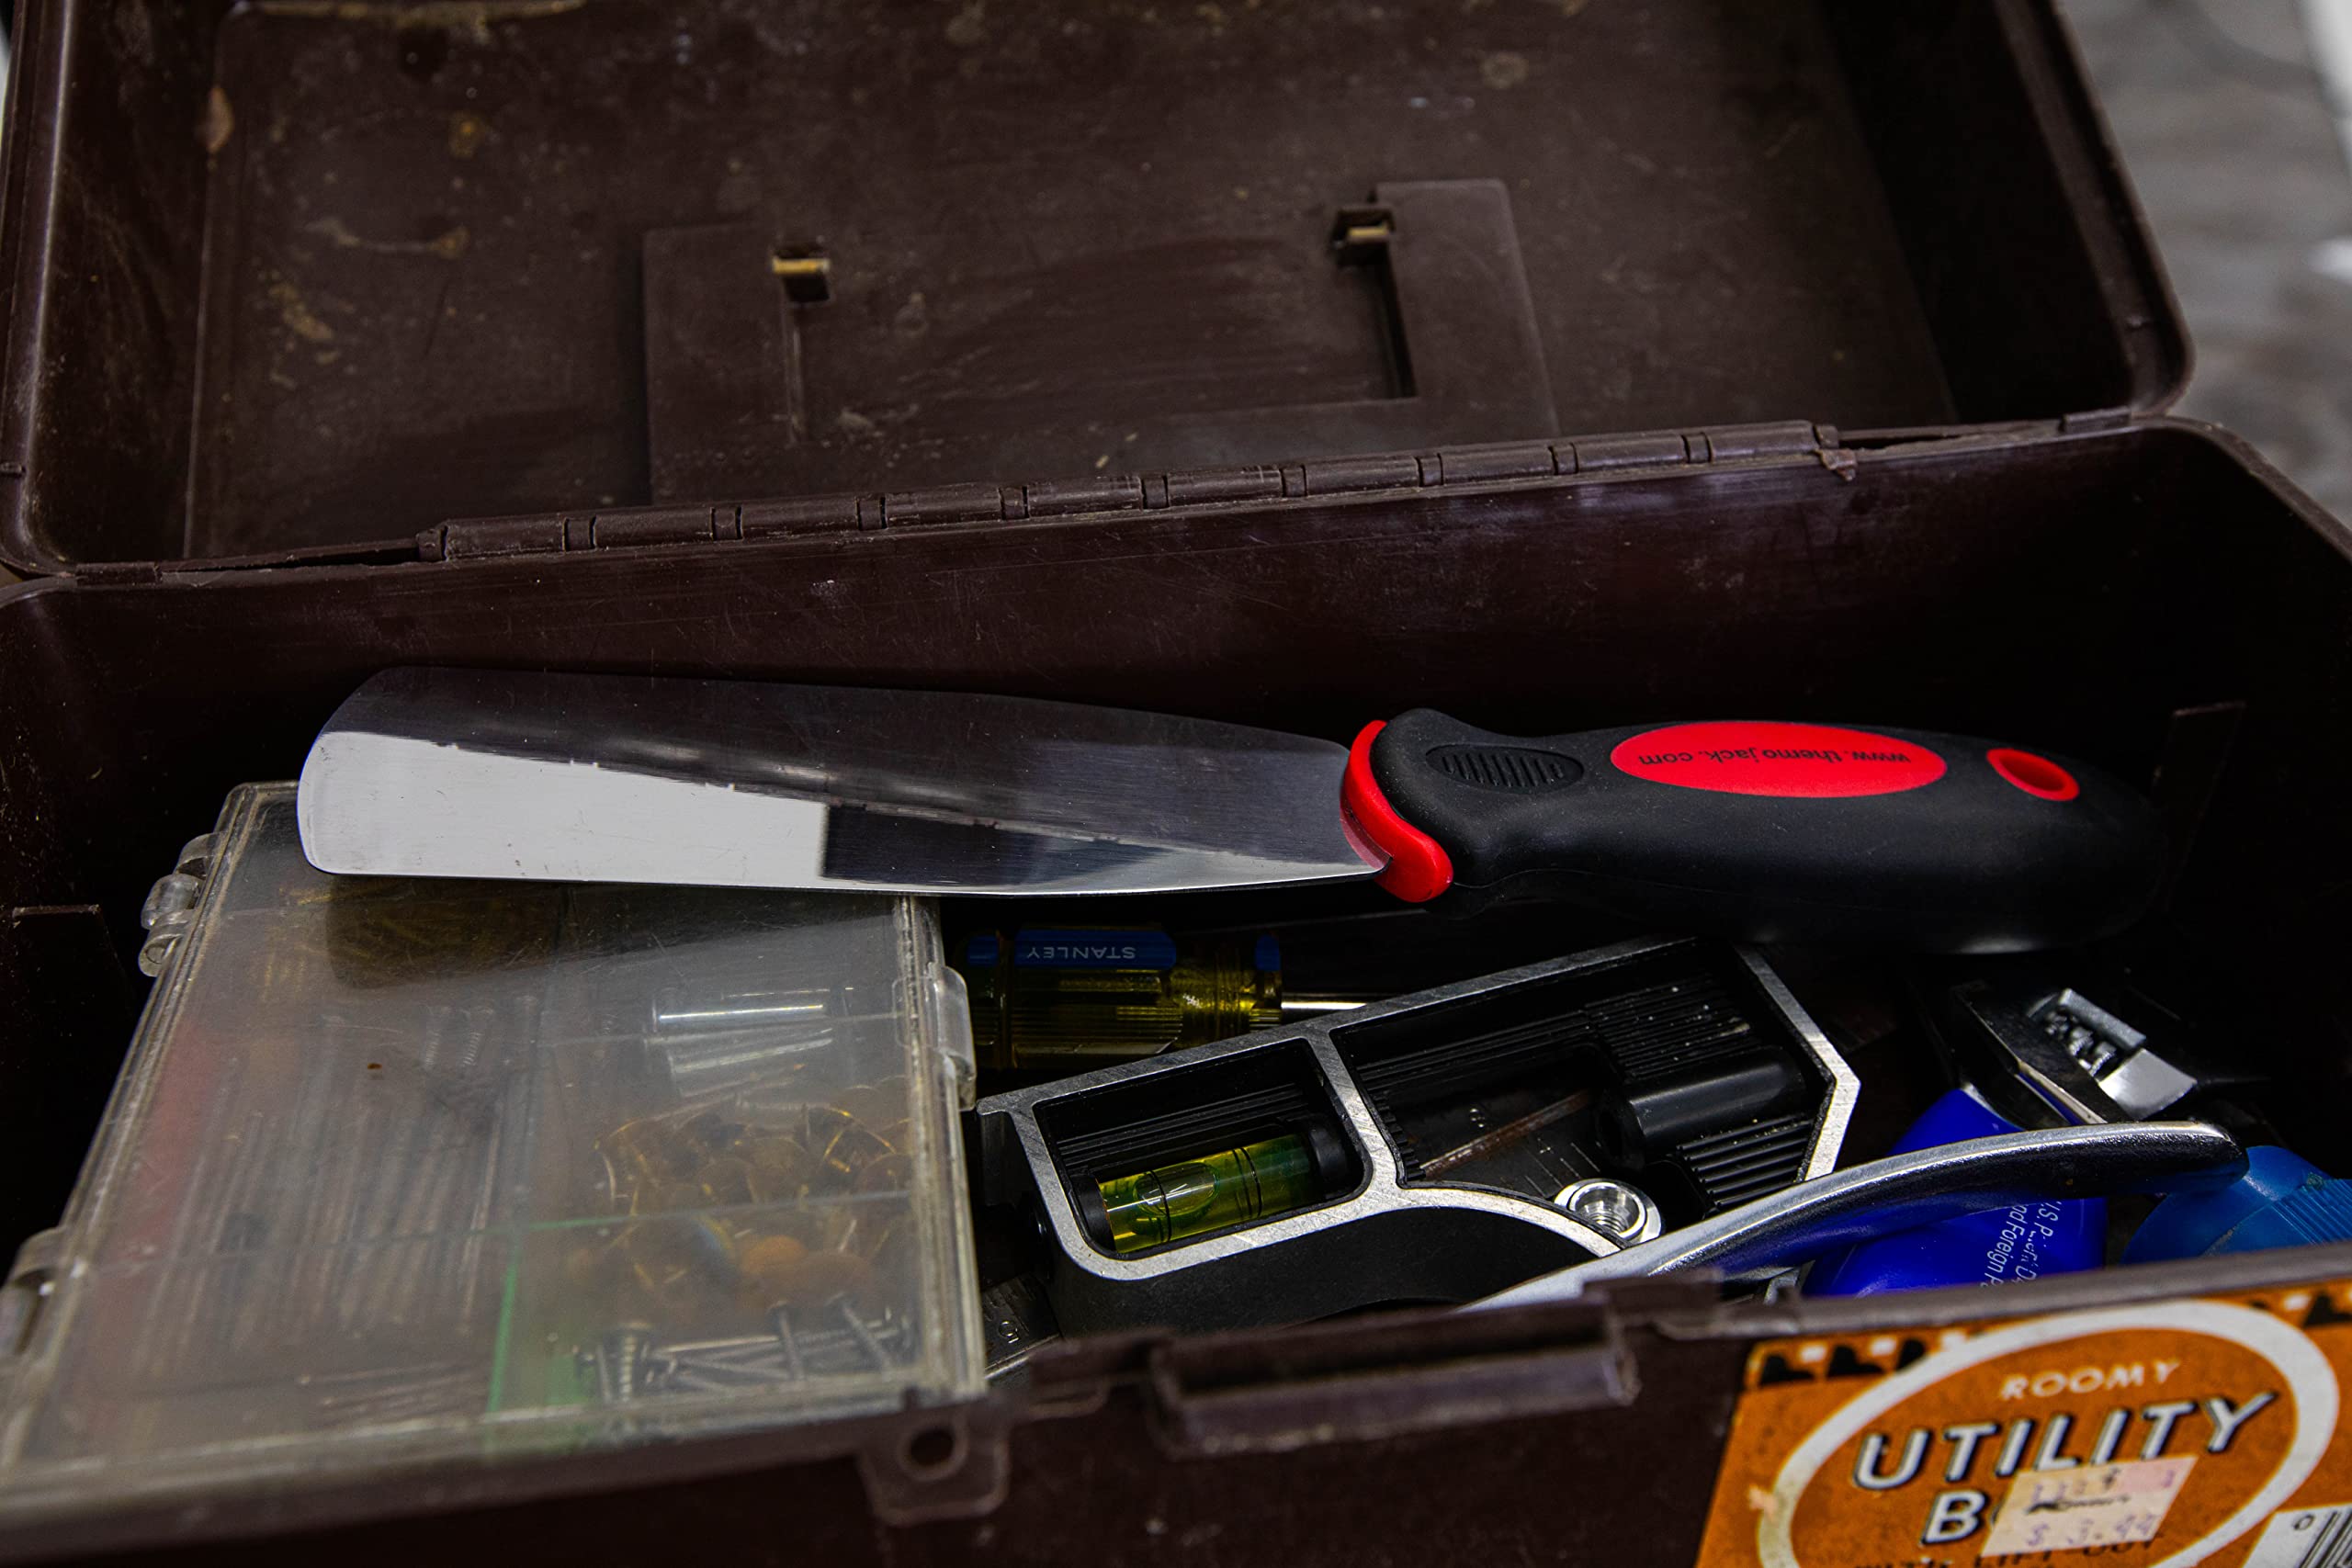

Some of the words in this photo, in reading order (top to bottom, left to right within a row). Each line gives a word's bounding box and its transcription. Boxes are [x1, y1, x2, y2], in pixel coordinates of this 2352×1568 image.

[1026, 947, 1136, 959] STANLEY
[1986, 1221, 2025, 1273] Foreign
[2001, 1361, 2180, 1399] ROOMY
[1852, 1392, 2278, 1489] UTILITY
